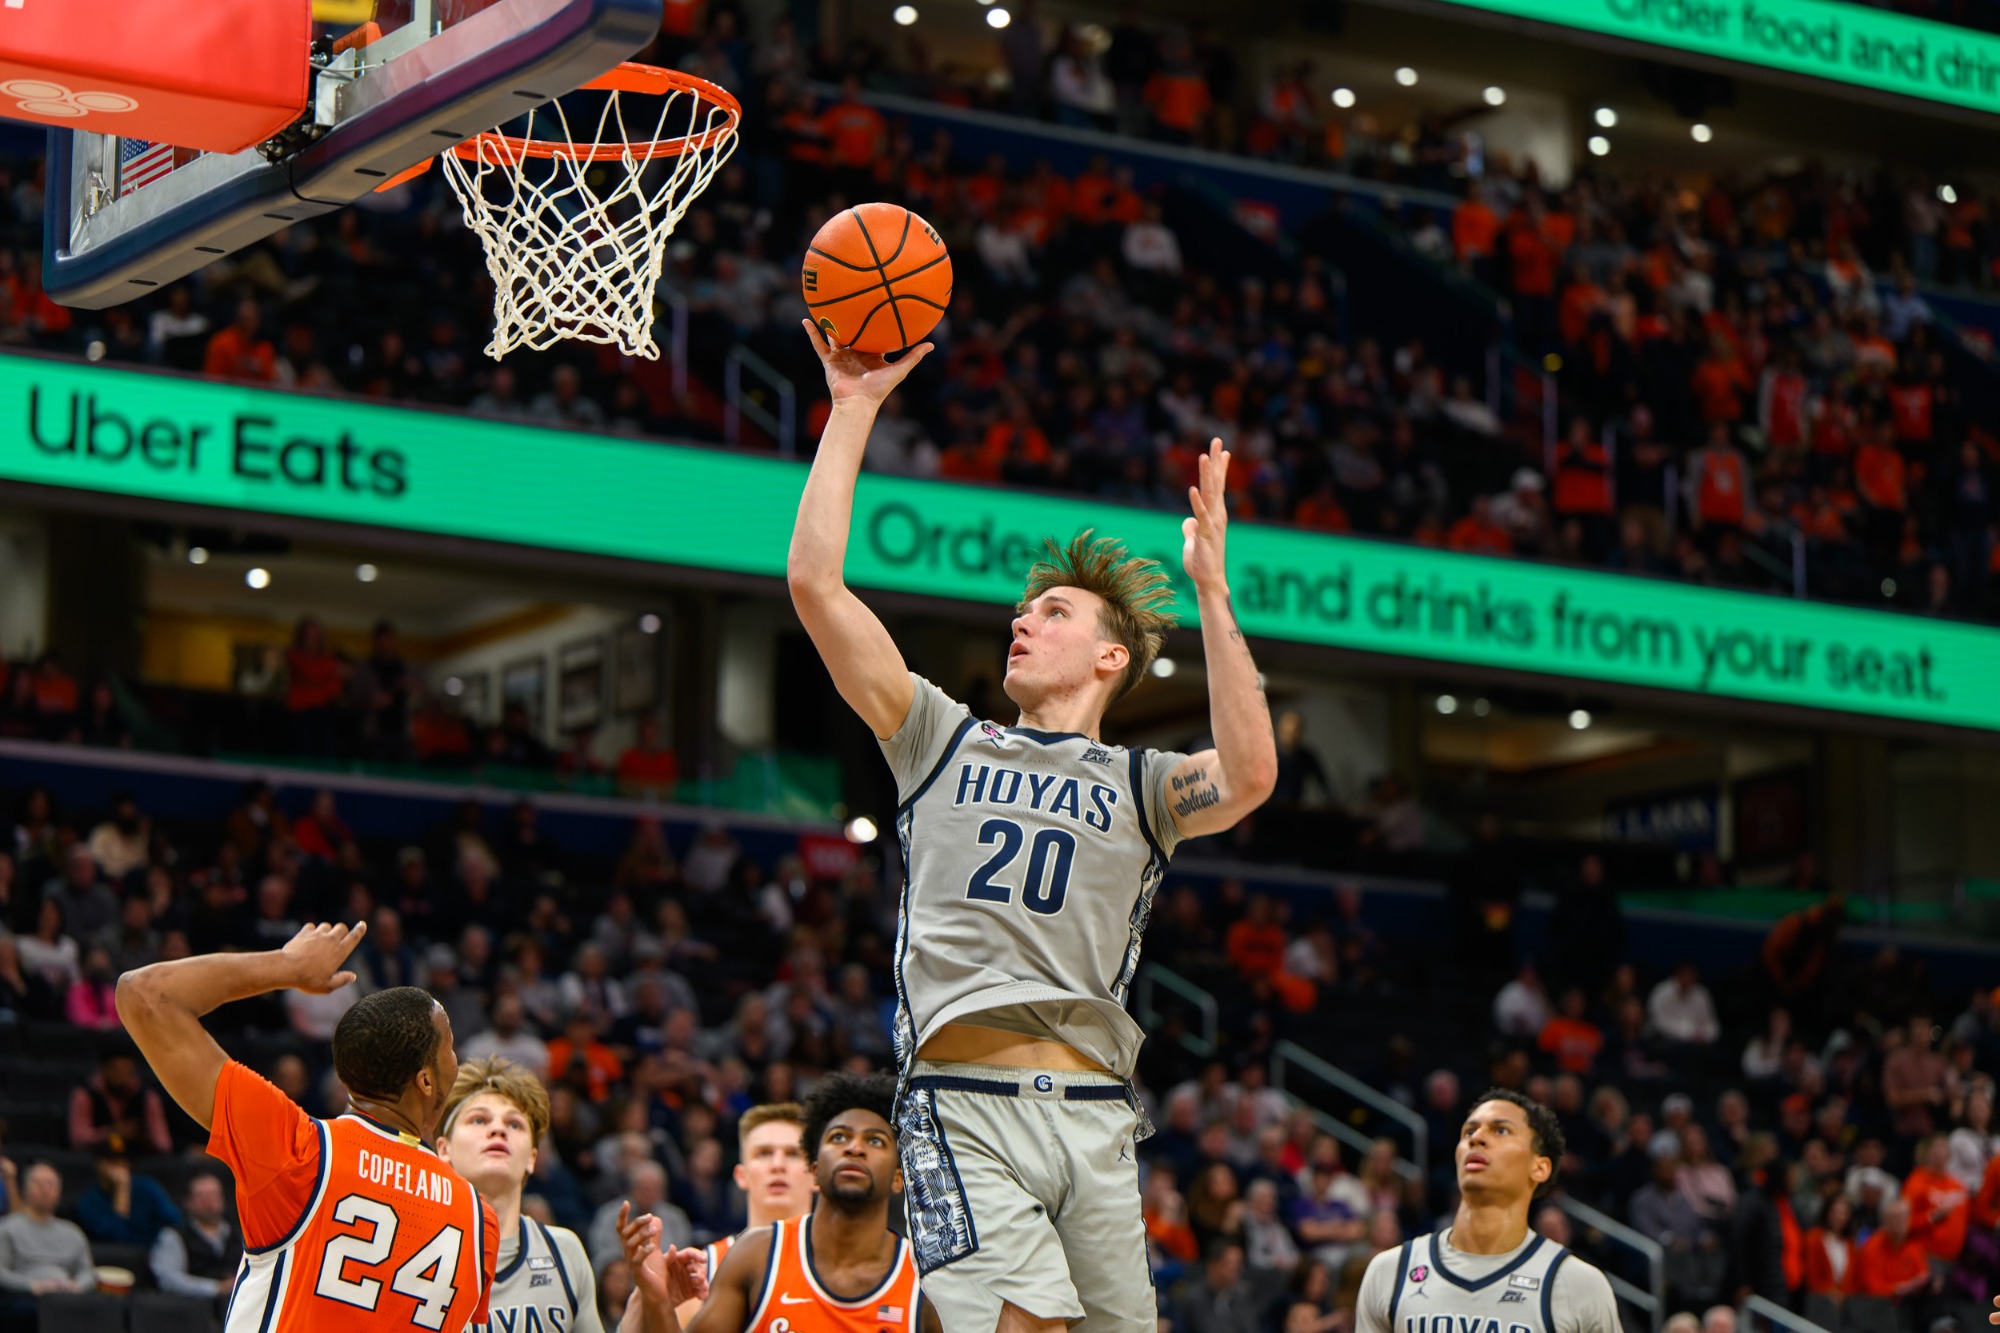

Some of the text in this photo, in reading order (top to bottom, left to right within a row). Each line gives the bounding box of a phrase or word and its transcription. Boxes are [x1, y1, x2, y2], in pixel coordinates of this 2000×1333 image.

[1741, 4, 1842, 62] food
[1849, 33, 1926, 82] and
[28, 384, 408, 500] Uber Eats
[1238, 562, 1352, 624] and
[1365, 572, 1537, 648] drinks
[1551, 590, 1684, 667] from
[1692, 622, 1812, 694] your
[1824, 638, 1946, 704] seat.
[1081, 753, 1114, 765] EAST
[1086, 747, 1109, 757] BIG
[954, 763, 1118, 833] HOYAS
[965, 818, 1077, 917] 20
[1033, 1074, 1054, 1094] G
[358, 1149, 453, 1207] COPELAND
[315, 1192, 464, 1332] 24
